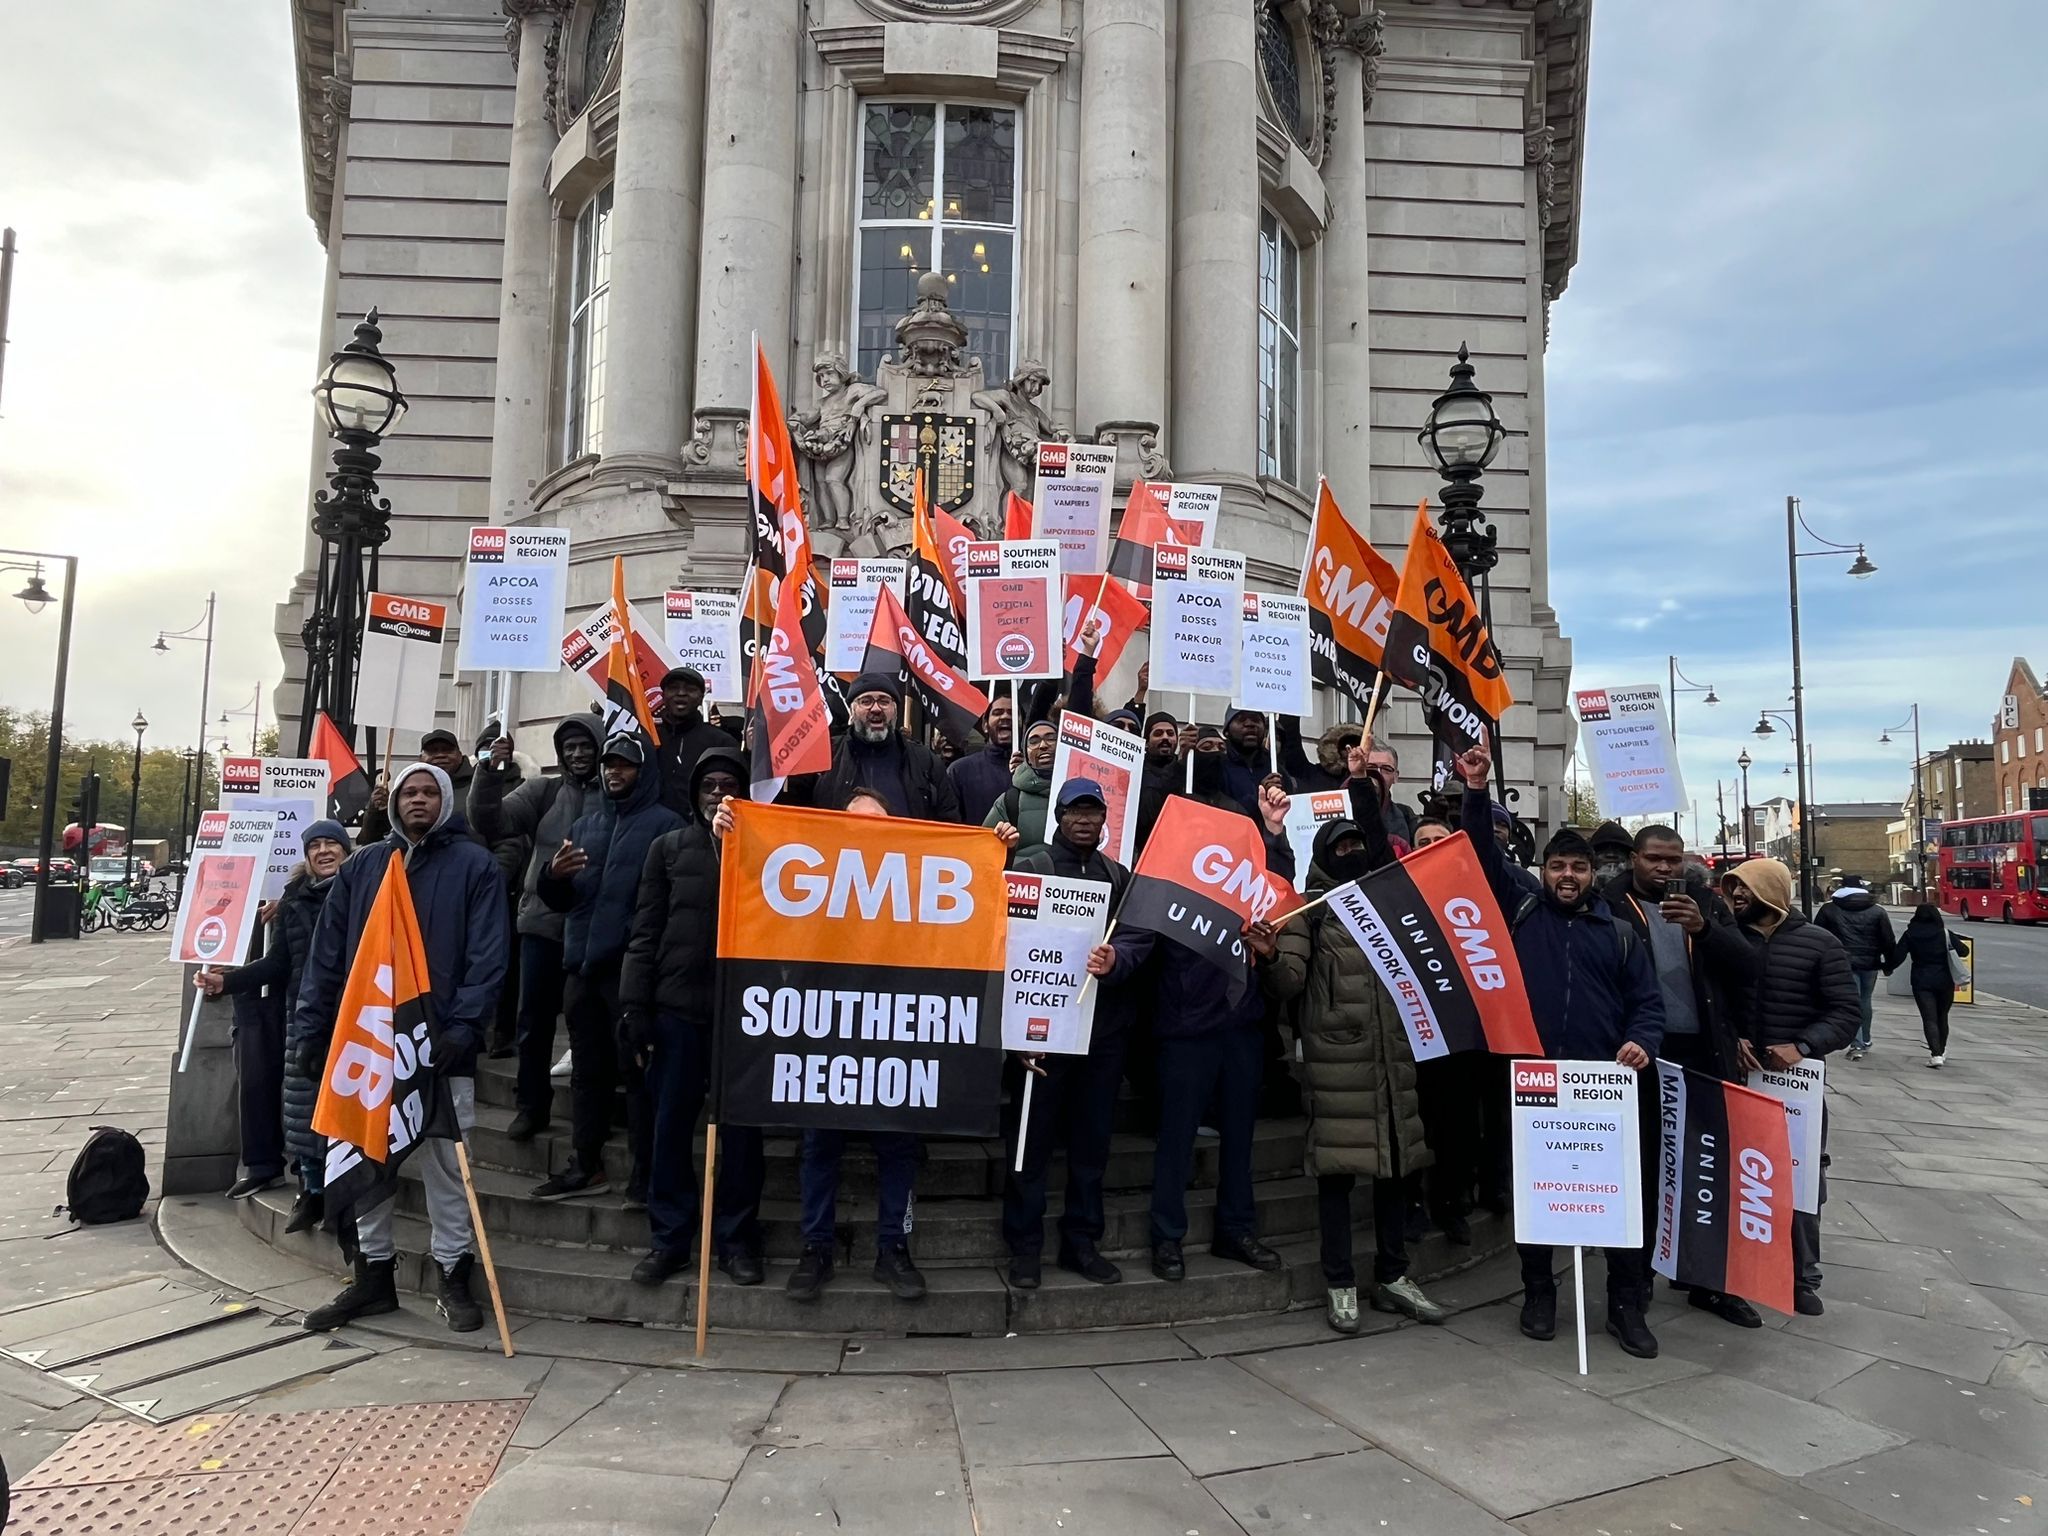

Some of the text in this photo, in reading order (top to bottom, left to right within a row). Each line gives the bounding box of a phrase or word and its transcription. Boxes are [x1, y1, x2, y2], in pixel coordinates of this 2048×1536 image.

[1041, 451, 1065, 463] GMB
[1070, 453, 1114, 463] SOUTHERN
[1076, 465, 1106, 474] REGION
[1174, 491, 1218, 501] SOUTHERN
[1178, 502, 1209, 510] REGION
[1044, 528, 1095, 536] IMPOVERISHED
[472, 535, 504, 548] GMB
[510, 536, 566, 546] SOUTHERN
[517, 548, 557, 557] REGION
[970, 550, 998, 562] GMB
[1004, 549, 1056, 558] SOUTHERN
[1158, 551, 1187, 566] GMB
[1011, 560, 1049, 569] REGION
[1191, 556, 1242, 569] SOUTHERN
[833, 565, 856, 575] GMB
[861, 566, 904, 574] SOUTHERN
[1199, 570, 1234, 580] REGION
[489, 576, 538, 587] APCOA
[493, 597, 532, 606] BOSSES
[668, 597, 691, 607] GMB
[695, 600, 736, 608] SOUTHERN
[1177, 593, 1222, 608] APCOA
[1261, 600, 1306, 612] SOUTHERN
[387, 601, 430, 620] GMB
[1268, 611, 1300, 621] REGION
[485, 615, 537, 624] PARK OUR
[1182, 615, 1216, 626] BOSSES
[490, 634, 528, 642] WAGES
[689, 636, 713, 645] GMB
[1175, 633, 1222, 645] PARK OUR
[1250, 634, 1289, 647] APCOA
[562, 636, 587, 658] GMB
[572, 648, 596, 670] UNION
[680, 649, 725, 659] OFFICIAL
[898, 626, 954, 691] GMB
[1180, 652, 1215, 663] WAGES
[1255, 652, 1287, 661] BOSSES
[686, 663, 721, 672] PICKET
[1250, 665, 1291, 677] PARK OUR
[1256, 682, 1287, 691] WAGES
[1579, 696, 1606, 708] GMB
[1611, 691, 1660, 702] SOUTHERN
[1620, 703, 1655, 712] REGION
[2005, 696, 2014, 727] UPC
[1064, 719, 1091, 737] GMB
[1596, 725, 1654, 736] OUTSOURCING
[1062, 736, 1089, 749] UNION
[1096, 729, 1142, 754] SOUTHERN
[1608, 740, 1649, 749] VAMPIRES
[1101, 743, 1134, 762] REGION
[224, 765, 259, 777] GMB
[265, 766, 325, 777] SOUTHERN
[1606, 768, 1665, 779] IMPOVERISHED
[274, 780, 316, 788] REGION
[1619, 783, 1660, 792] WORKERS
[1314, 799, 1343, 810] GMB
[202, 820, 226, 832] GMB
[229, 821, 273, 830] SOUTHERN
[233, 834, 264, 843] REGION
[274, 848, 296, 856] OUR
[761, 843, 974, 924] GMB
[1008, 884, 1038, 900] GMB
[1045, 888, 1106, 904] SOUTHERN
[1009, 907, 1037, 916] NION
[1052, 904, 1095, 917] REGION
[1444, 897, 1506, 991] GMB
[1029, 949, 1062, 964] GMB
[1401, 913, 1452, 992] UNION
[1340, 893, 1434, 1047] MAKE WORK BETTER.
[1011, 969, 1077, 987] OFFICIAL
[1015, 992, 1068, 1007] PICKET
[742, 986, 978, 1044] SOUTHERN
[771, 1054, 940, 1108] REGION
[1517, 1071, 1556, 1087] GMB
[1562, 1073, 1632, 1086] SOUTHERN
[1762, 1074, 1809, 1092] REGION
[1517, 1095, 1557, 1104] UNION
[1573, 1088, 1623, 1100] REGION
[1532, 1120, 1616, 1132] OUTSOURCING
[1546, 1141, 1604, 1152] VAMPIRES
[1660, 1074, 1678, 1261] MAKE WORK BETTER.
[1697, 1134, 1715, 1224] UNION
[1534, 1182, 1618, 1194] IMPOVERISHED
[1739, 1148, 1773, 1244] GMB
[1549, 1203, 1605, 1214] WORKERS
